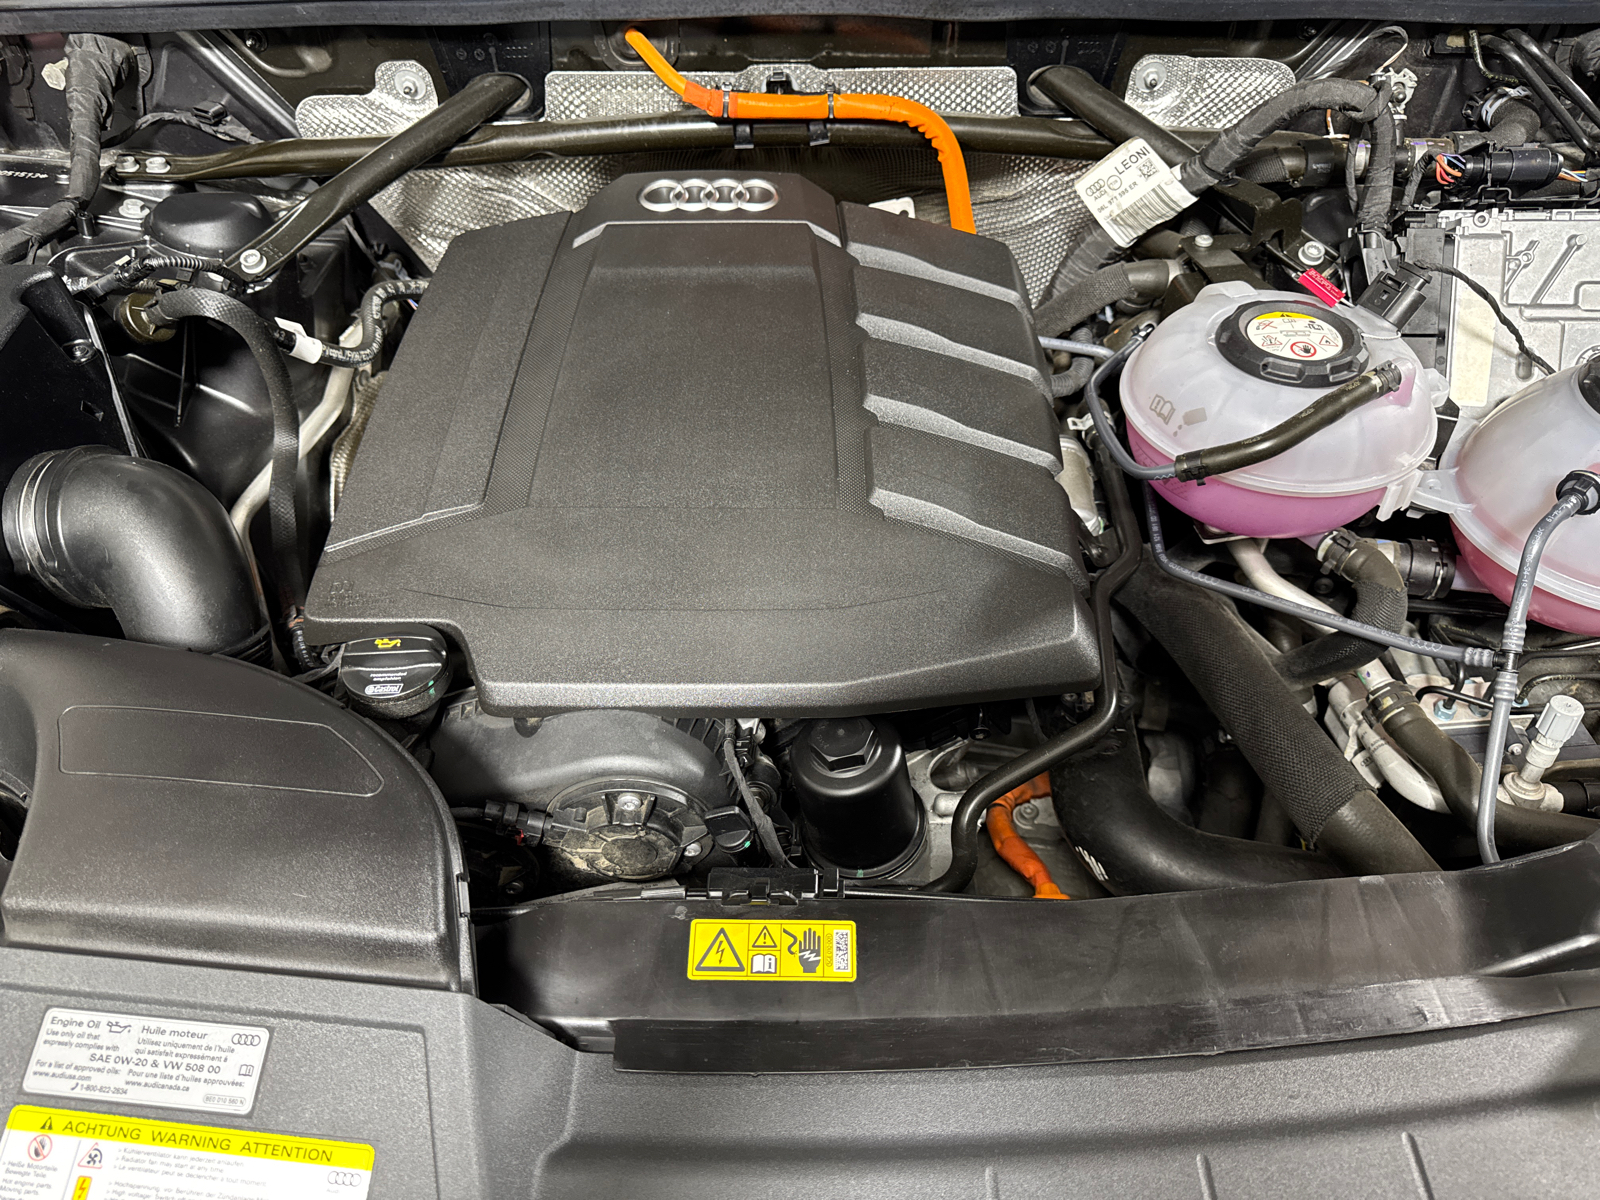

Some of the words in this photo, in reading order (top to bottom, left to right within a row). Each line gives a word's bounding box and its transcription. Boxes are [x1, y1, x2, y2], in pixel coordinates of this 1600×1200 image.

[1114, 146, 1150, 175] LEONI
[1128, 181, 1138, 191] ER
[1094, 190, 1108, 202] AUDI
[50, 1016, 84, 1028] Engine
[87, 1020, 101, 1029] Oil
[142, 1025, 166, 1036] Huile
[169, 1030, 208, 1040] moteur
[43, 1039, 74, 1048] expressly
[75, 1042, 104, 1050] complies
[138, 1038, 161, 1047] Utilisez
[163, 1040, 202, 1051] uniquement
[135, 1048, 146, 1056] qui
[147, 1049, 174, 1057] satisfait
[74, 1065, 105, 1074] approved
[89, 1053, 112, 1064] SAE
[114, 1056, 148, 1067] 0W-20
[151, 1060, 159, 1068] &
[163, 1060, 183, 1070] VW
[185, 1063, 205, 1072] 508
[207, 1065, 221, 1074] 00
[33, 1071, 92, 1081] www.audiusa.com
[128, 1069, 144, 1078] Pour
[159, 1071, 174, 1080] liste
[125, 1080, 190, 1092] www.audicanada.ca
[62, 1121, 142, 1140] ACHTUNG
[151, 1130, 231, 1150] WARNING
[240, 1141, 333, 1162] ATTENTION
